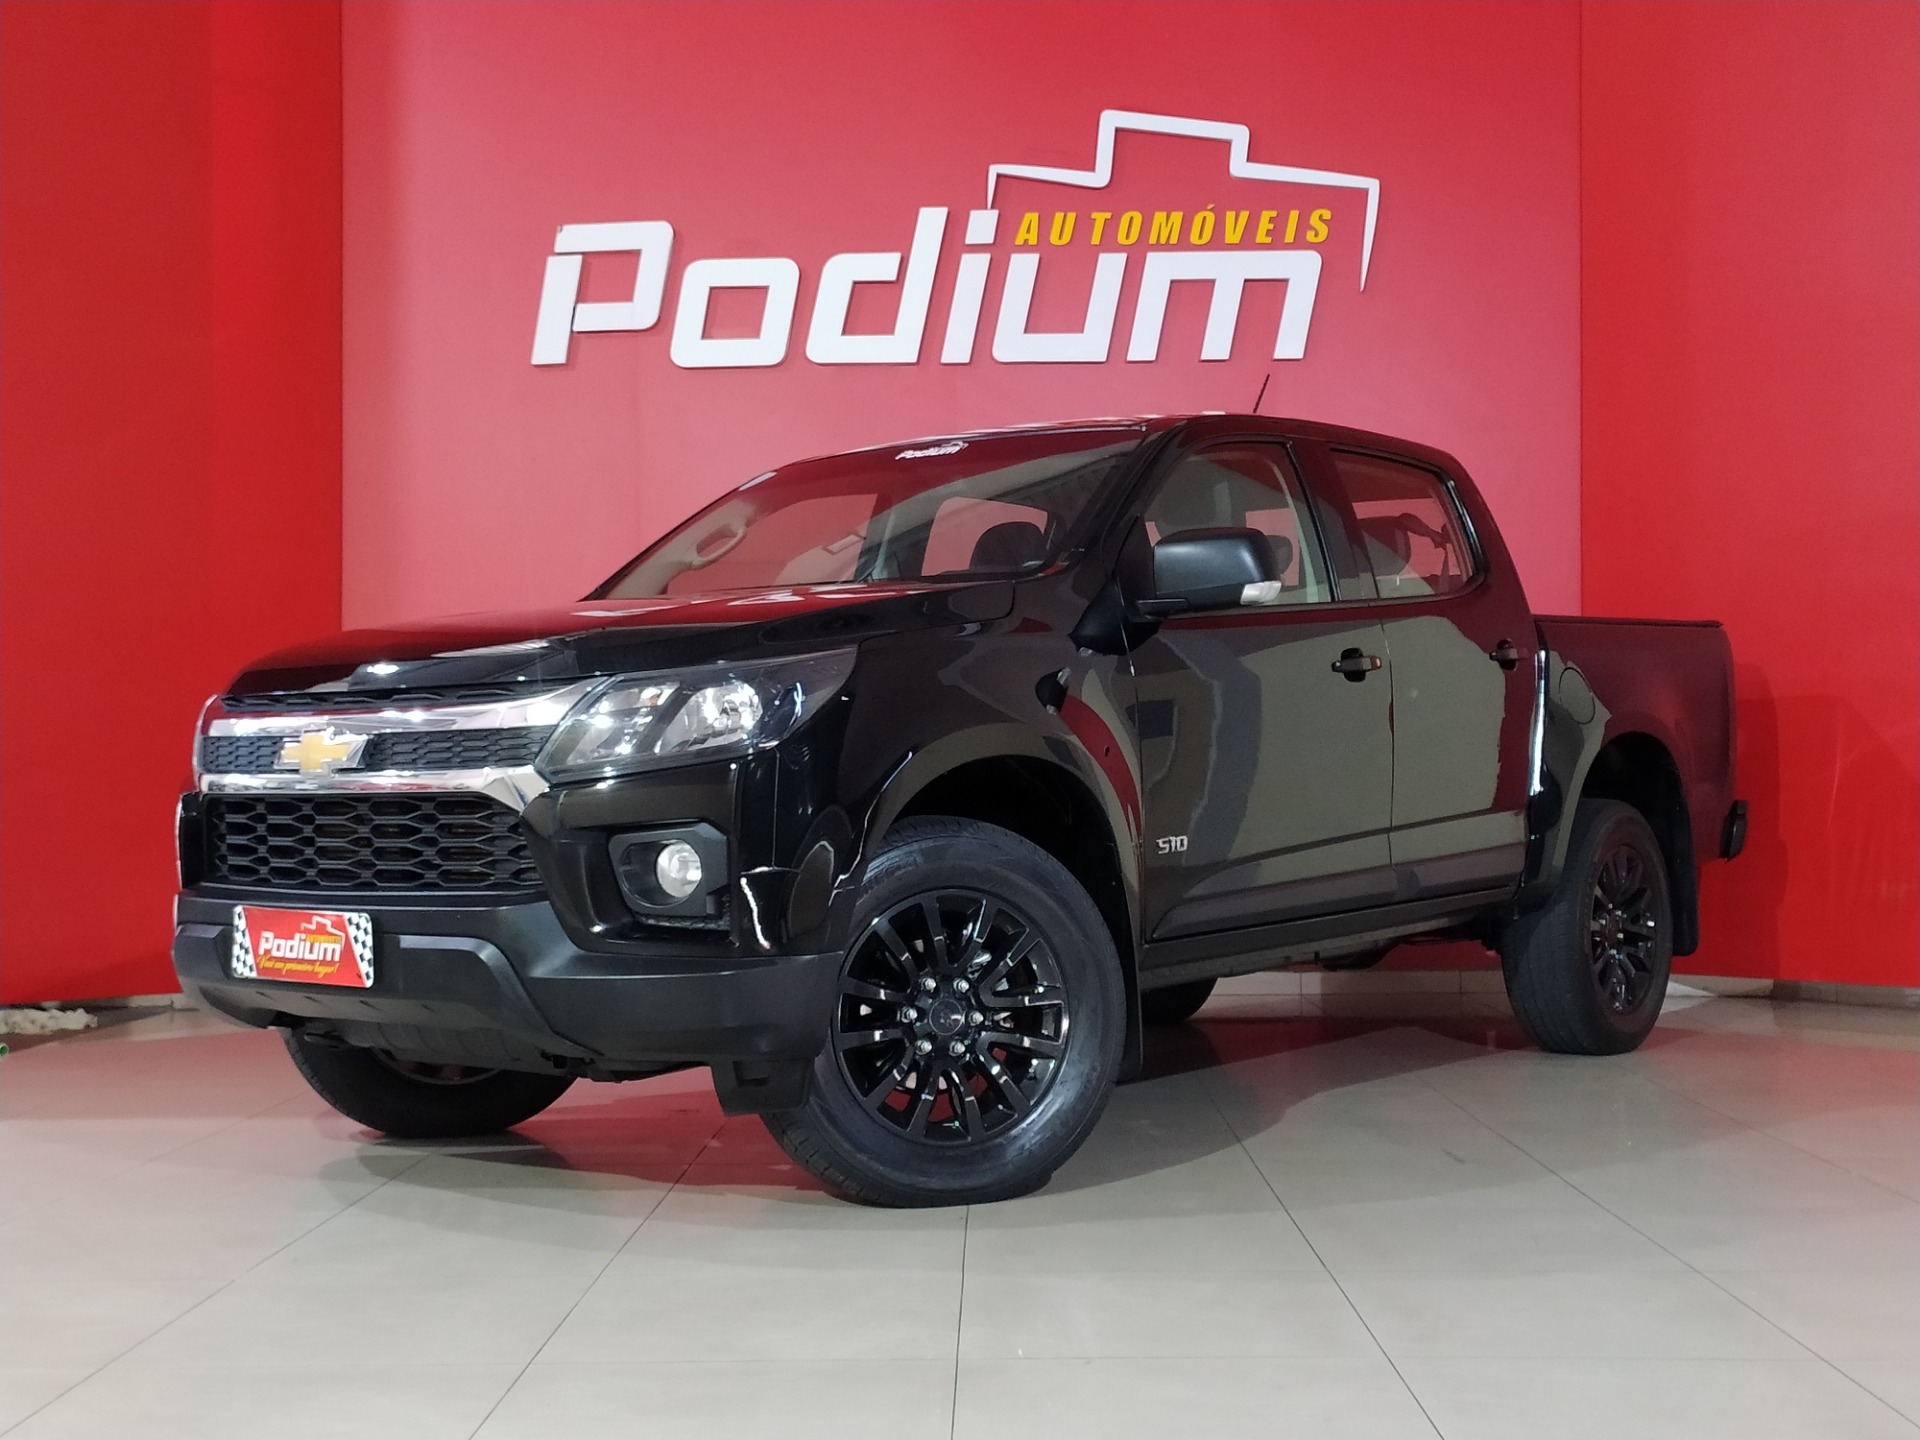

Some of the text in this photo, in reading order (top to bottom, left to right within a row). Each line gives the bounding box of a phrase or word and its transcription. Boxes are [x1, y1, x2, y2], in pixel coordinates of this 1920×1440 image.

[1014, 203, 1332, 246] AUTOMÓVEIS
[530, 206, 1323, 369] Podium
[1156, 835, 1189, 855] S10
[258, 930, 342, 962] Podium
